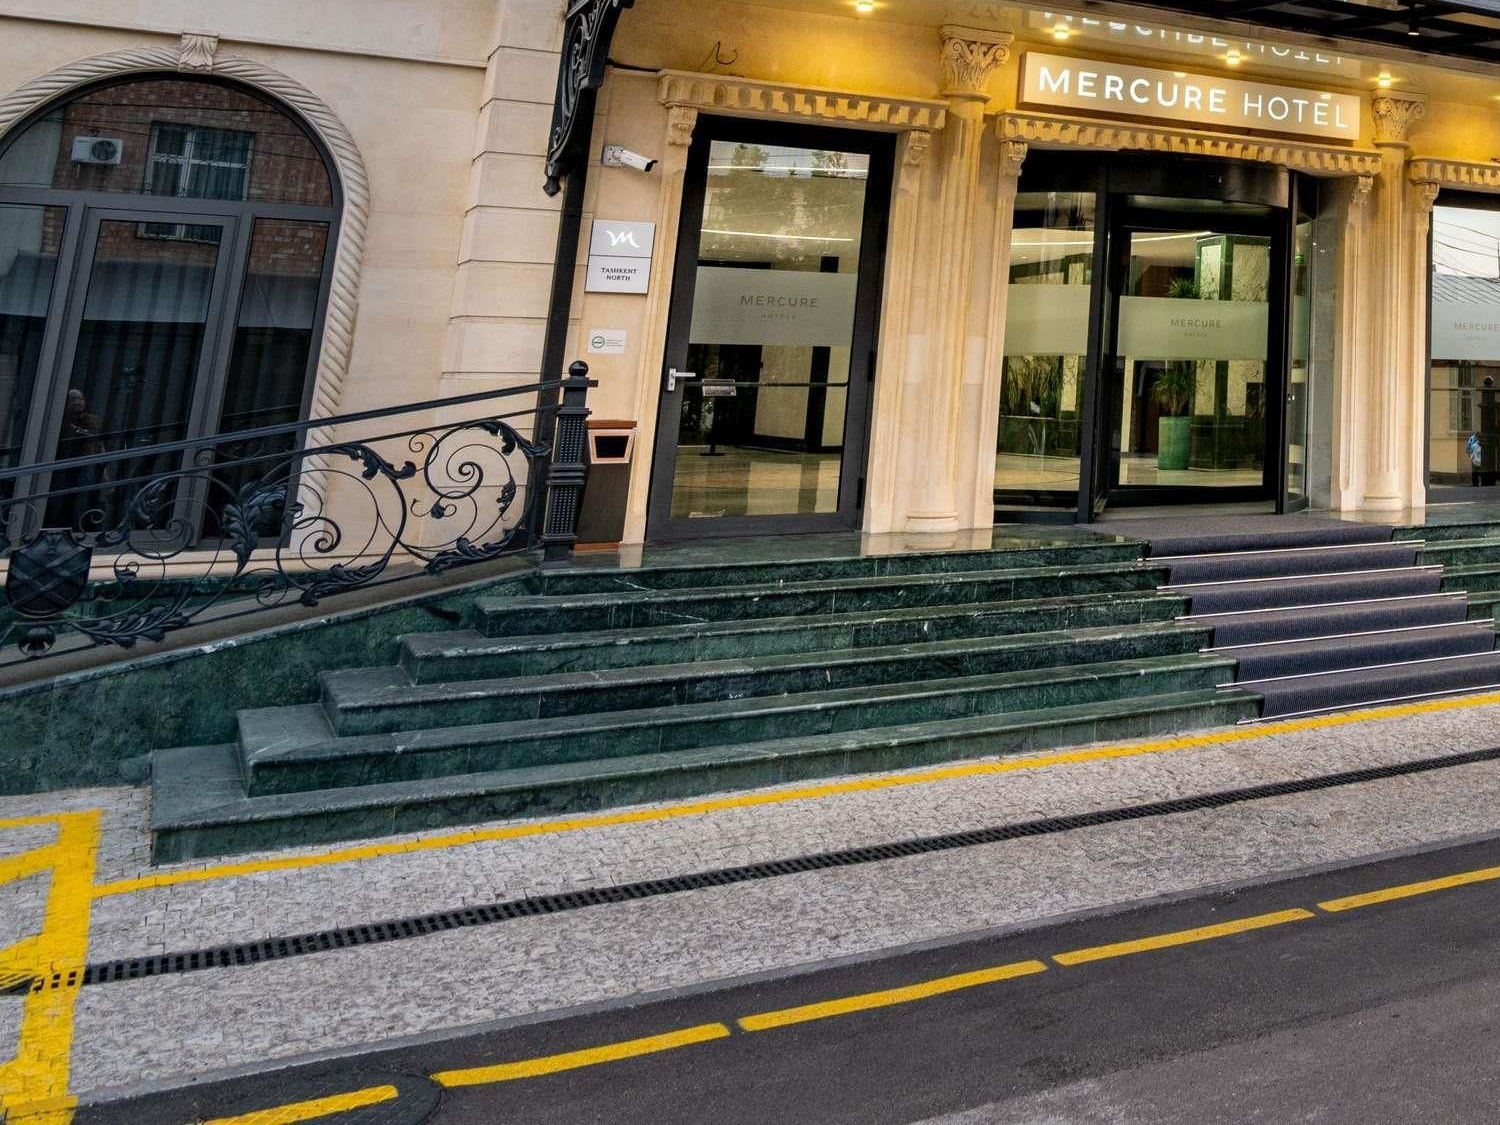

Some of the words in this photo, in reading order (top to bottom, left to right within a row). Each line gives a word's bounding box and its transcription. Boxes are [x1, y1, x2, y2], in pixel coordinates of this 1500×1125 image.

[1039, 66, 1227, 113] MERCURE
[1243, 93, 1349, 129] HOTEL
[740, 295, 818, 307] MERCURE
